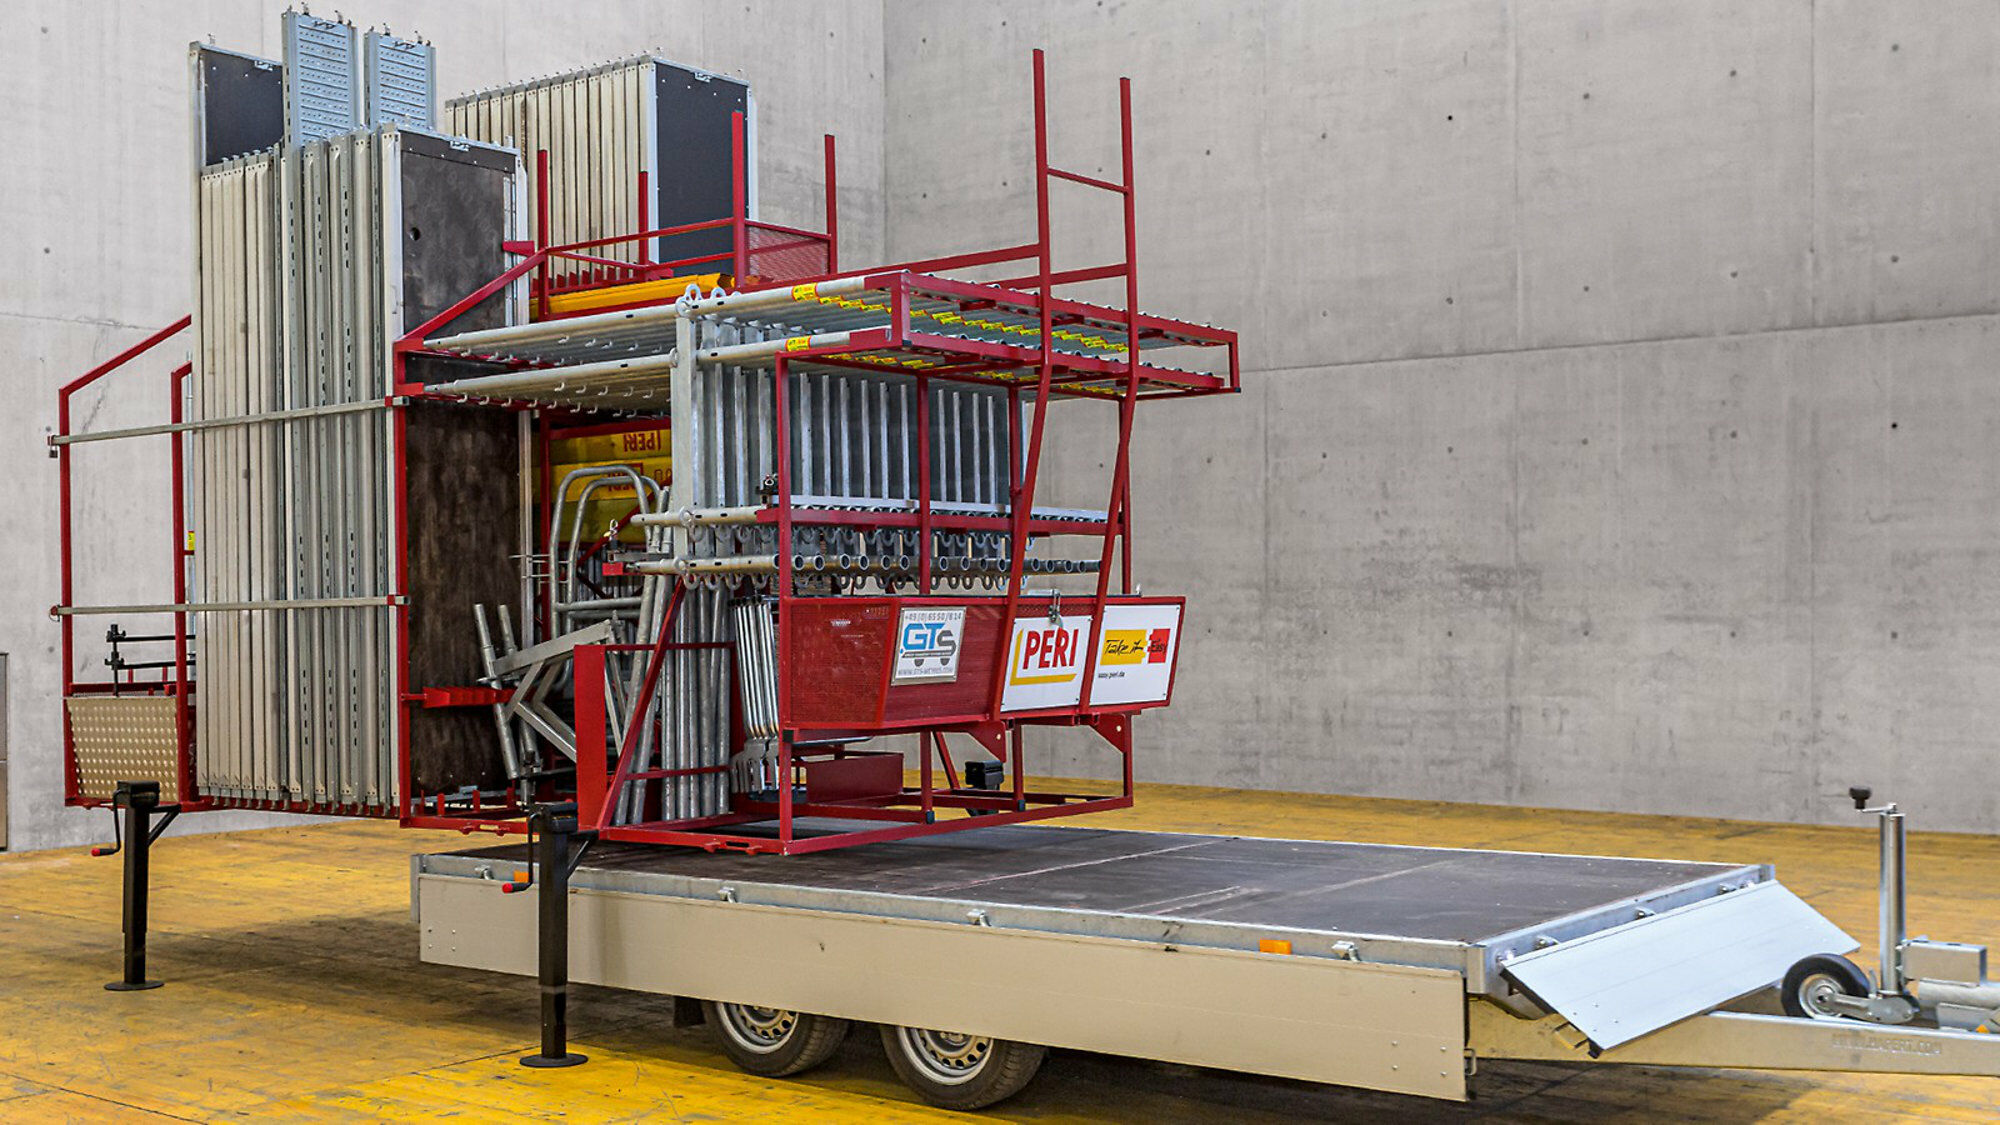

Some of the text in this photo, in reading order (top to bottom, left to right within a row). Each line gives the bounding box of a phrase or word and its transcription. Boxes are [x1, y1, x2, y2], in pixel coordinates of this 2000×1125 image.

[623, 432, 656, 452] PERI
[1023, 628, 1079, 670] PERI
[1105, 639, 1129, 655] Take
